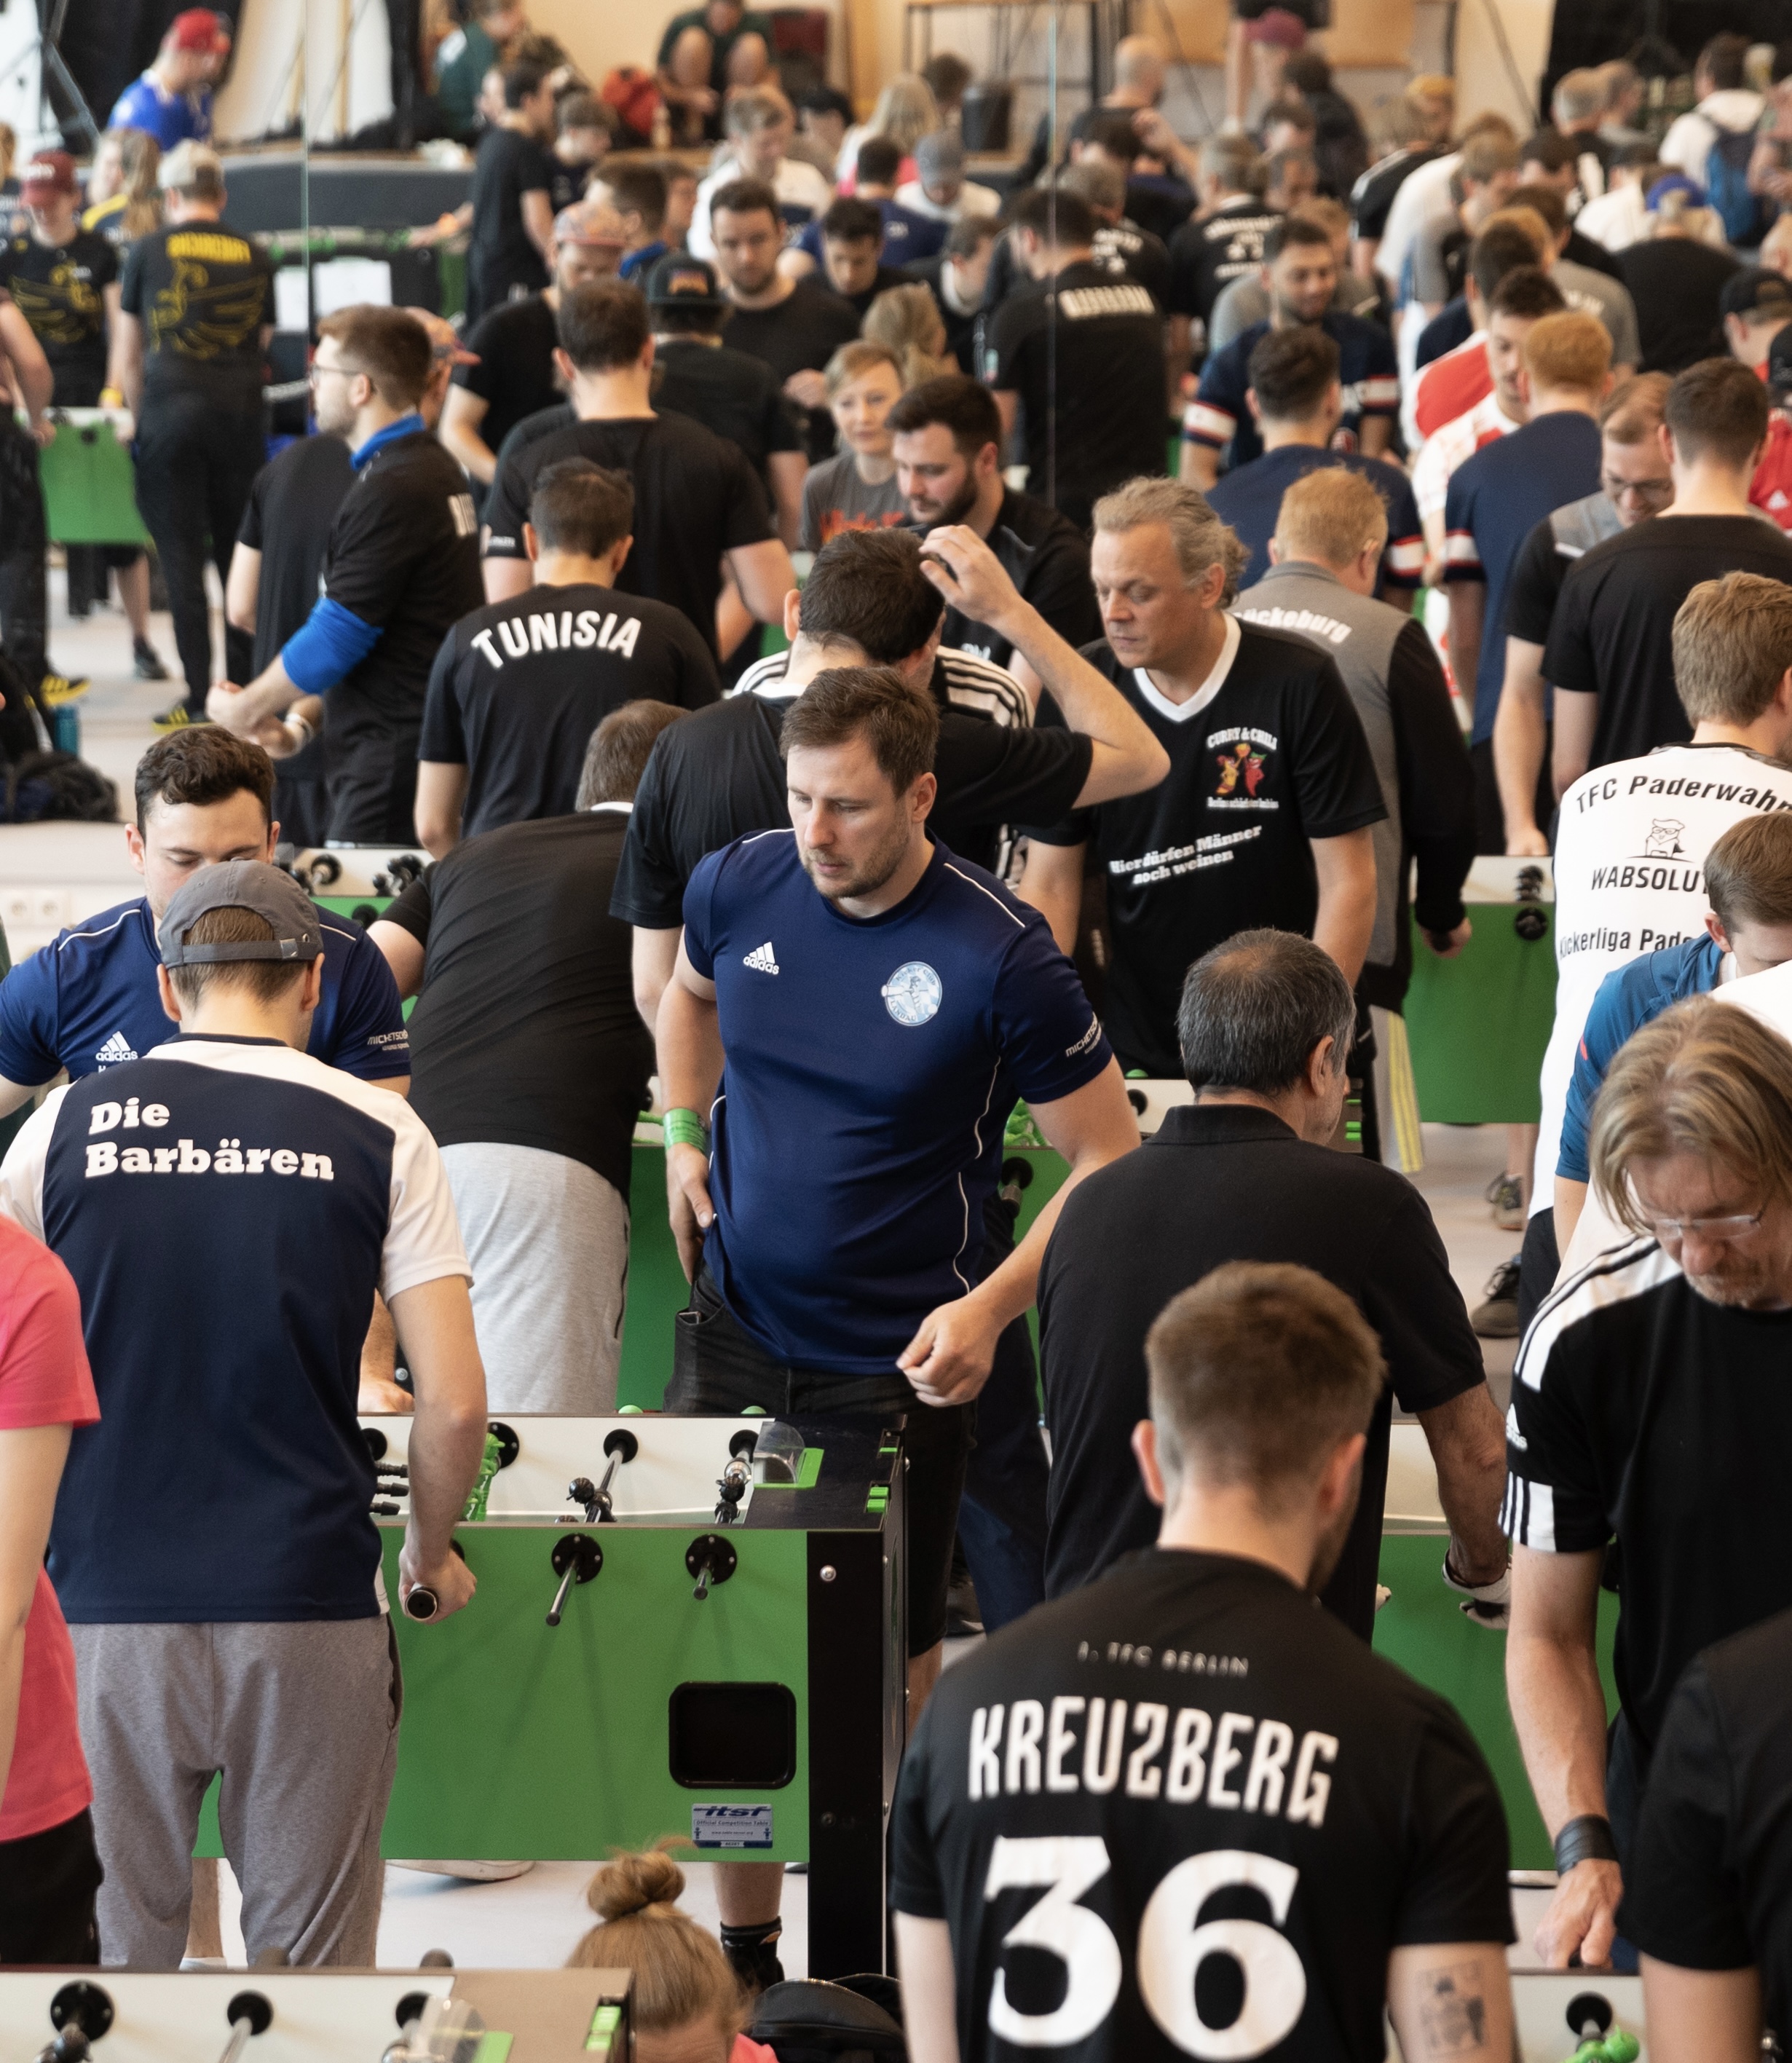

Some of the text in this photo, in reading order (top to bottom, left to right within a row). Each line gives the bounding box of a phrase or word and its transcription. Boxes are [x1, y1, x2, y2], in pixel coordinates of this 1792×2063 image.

[470, 610, 642, 668] TUNISIA
[1207, 727, 1277, 750] CURRY & CHILI
[1576, 778, 1617, 814] TFC
[1109, 825, 1262, 874] Hier dürfen Männer
[1133, 849, 1234, 885] noch weinen
[1591, 866, 1708, 894] WABSOLU
[1559, 928, 1631, 960] Kickerliga
[743, 955, 779, 975] adidas
[895, 967, 936, 985] Kicker Club
[891, 1000, 917, 1021] LANDAU
[95, 1049, 138, 1062] adidas
[89, 1097, 170, 1135] Die
[85, 1138, 334, 1180] Barbären
[1107, 1641, 1153, 1668] TFC
[1161, 1649, 1249, 1678] BERLIN
[968, 1695, 1339, 1829] KREUZBERG
[705, 1806, 767, 1816] itsf
[984, 1834, 1308, 2062] 36
